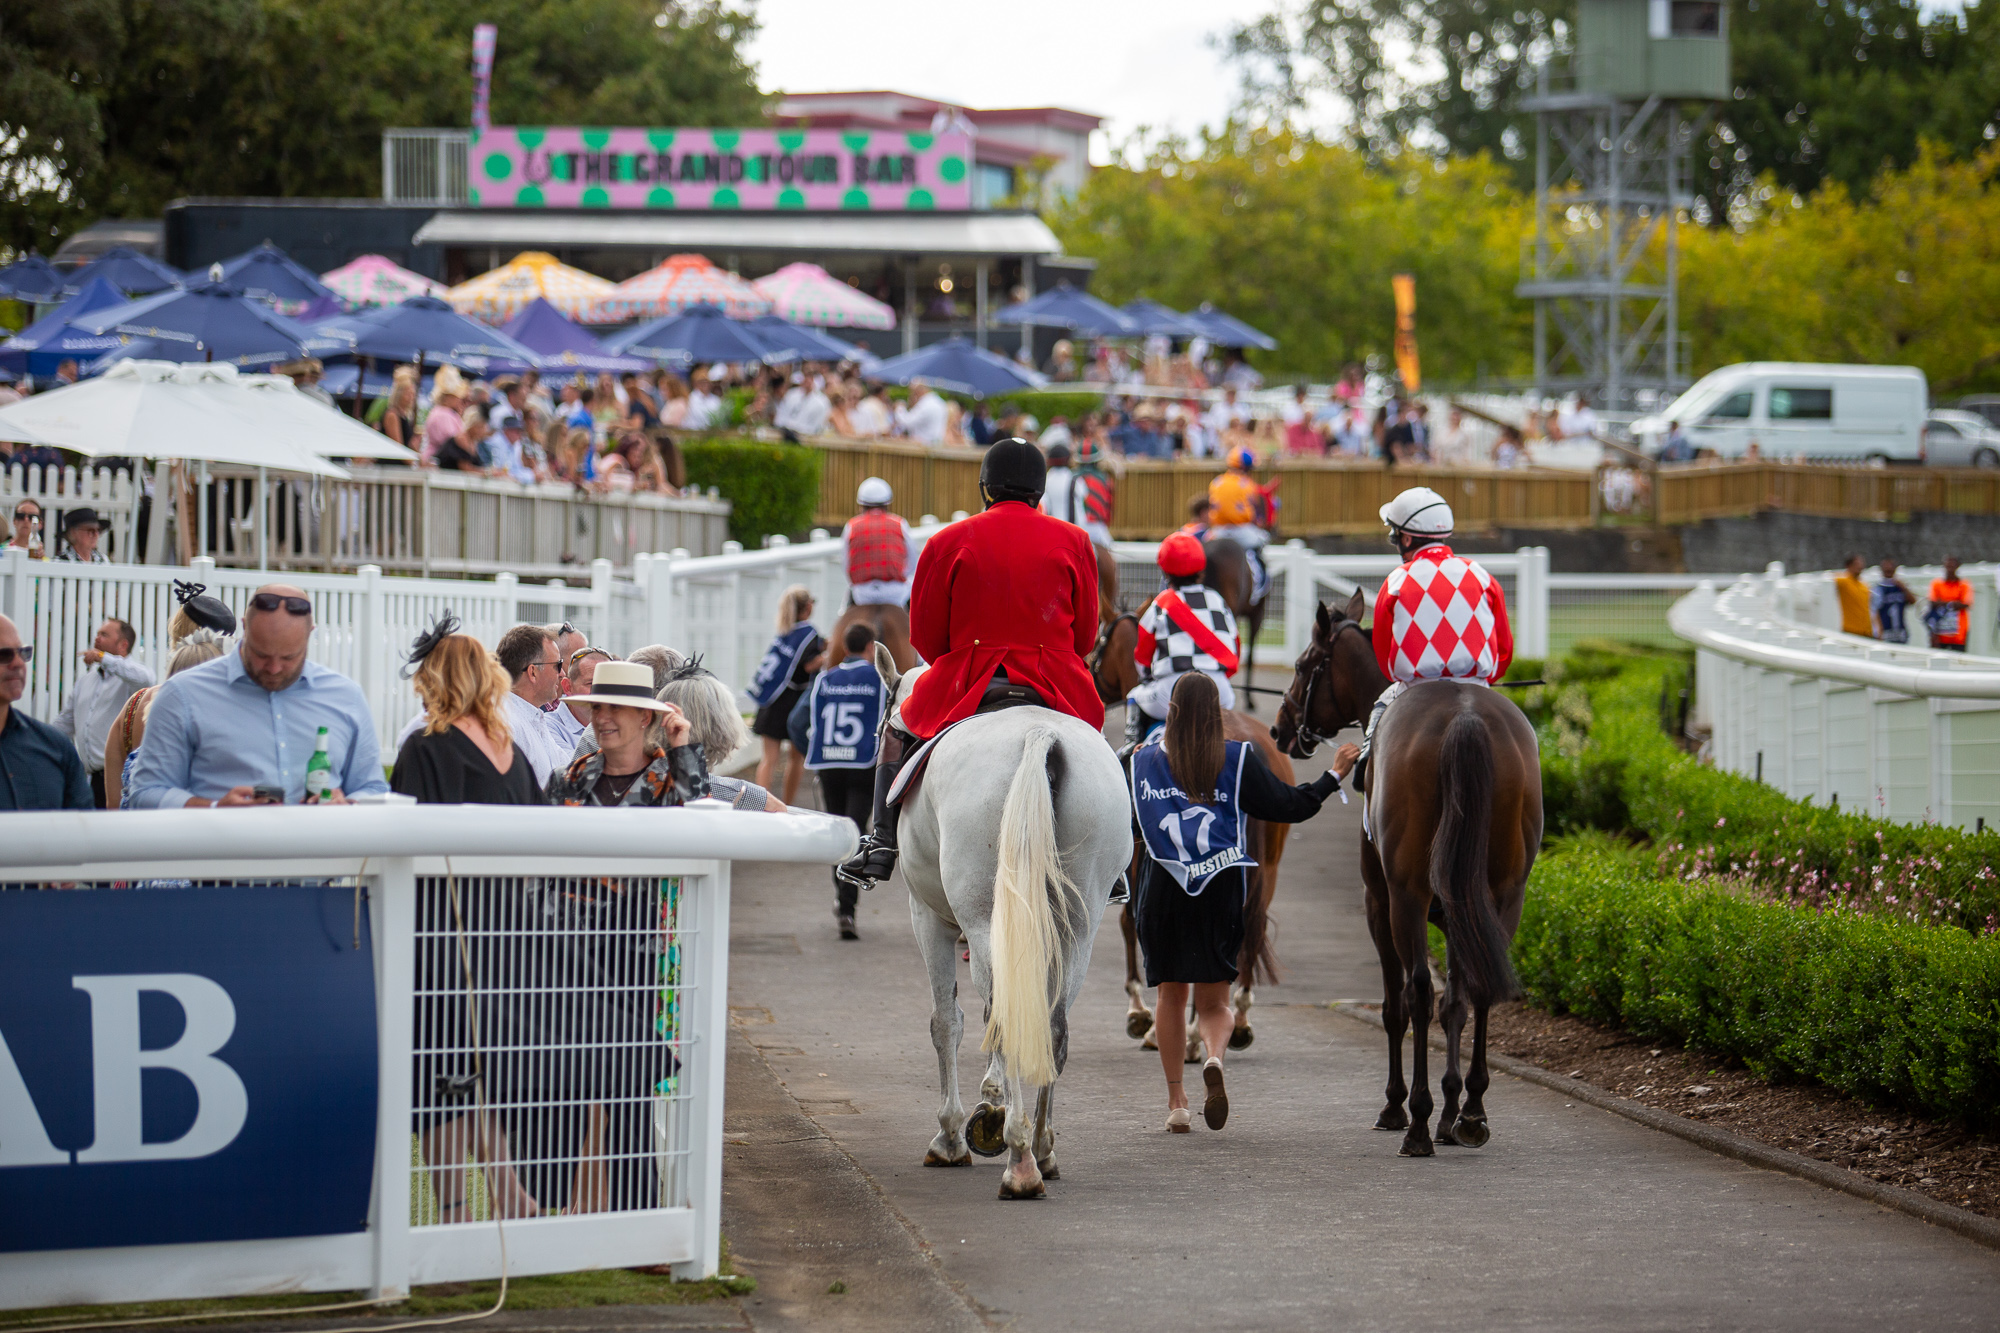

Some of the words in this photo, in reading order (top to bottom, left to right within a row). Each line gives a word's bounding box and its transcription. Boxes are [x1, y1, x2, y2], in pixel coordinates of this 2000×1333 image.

[567, 152, 620, 184] THE
[633, 152, 745, 184] GRAND
[759, 152, 840, 184] TOUR
[853, 152, 918, 184] BAR
[821, 702, 865, 747] 15
[1158, 805, 1217, 863] 17
[1186, 846, 1245, 882] HESTRAL
